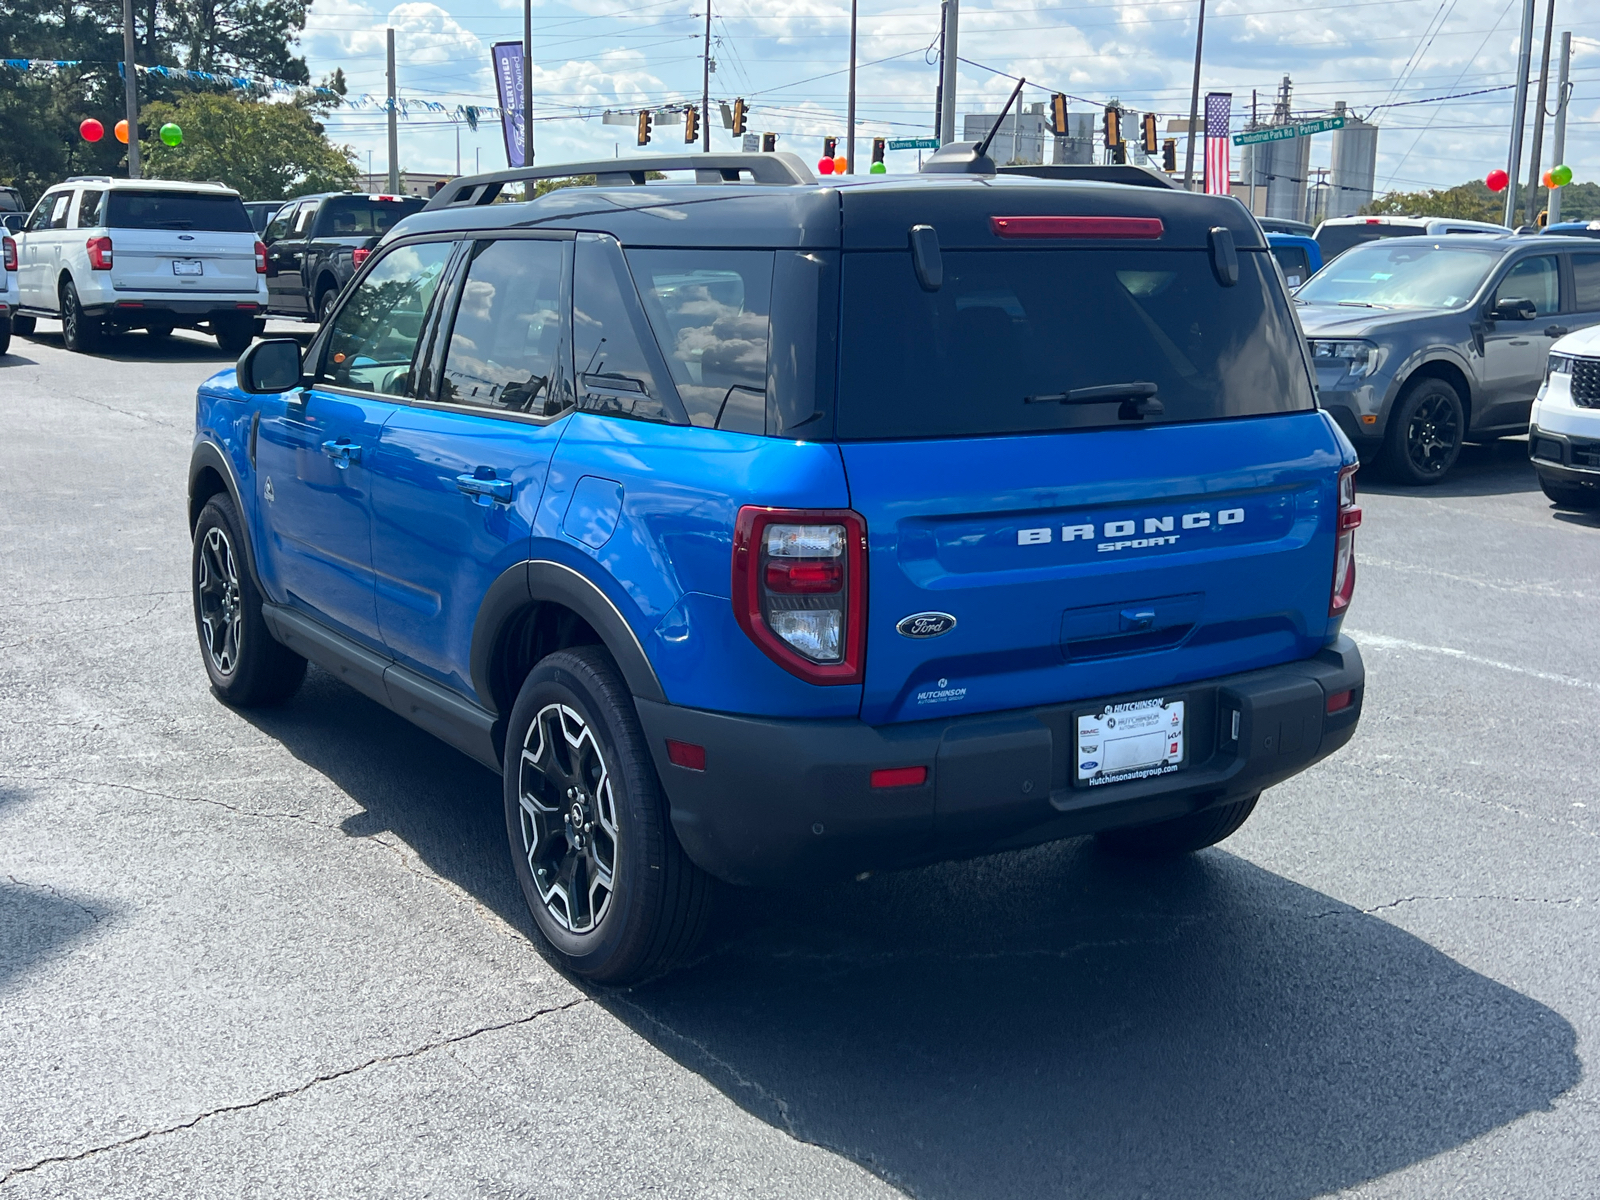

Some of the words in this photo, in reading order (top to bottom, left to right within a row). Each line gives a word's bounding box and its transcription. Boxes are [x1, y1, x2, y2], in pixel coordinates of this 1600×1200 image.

[502, 57, 515, 109] CERTIFIED
[1300, 123, 1320, 134] Patrol
[1324, 120, 1333, 129] Rd
[1243, 132, 1269, 143] Industrial
[1270, 130, 1283, 140] Park
[1284, 129, 1293, 137] Rd
[891, 141, 912, 149] Dames
[916, 140, 932, 148] Ferry
[1017, 508, 1245, 546] BRONCO
[1097, 535, 1180, 552] SPORT
[912, 618, 944, 633] Ford
[918, 688, 966, 699] HUTCHINSON
[918, 697, 948, 705] AUTOMOTIVE
[1114, 698, 1163, 713] HUTCHINSON
[1089, 765, 1177, 786] Hutchinsonautogroup.com
